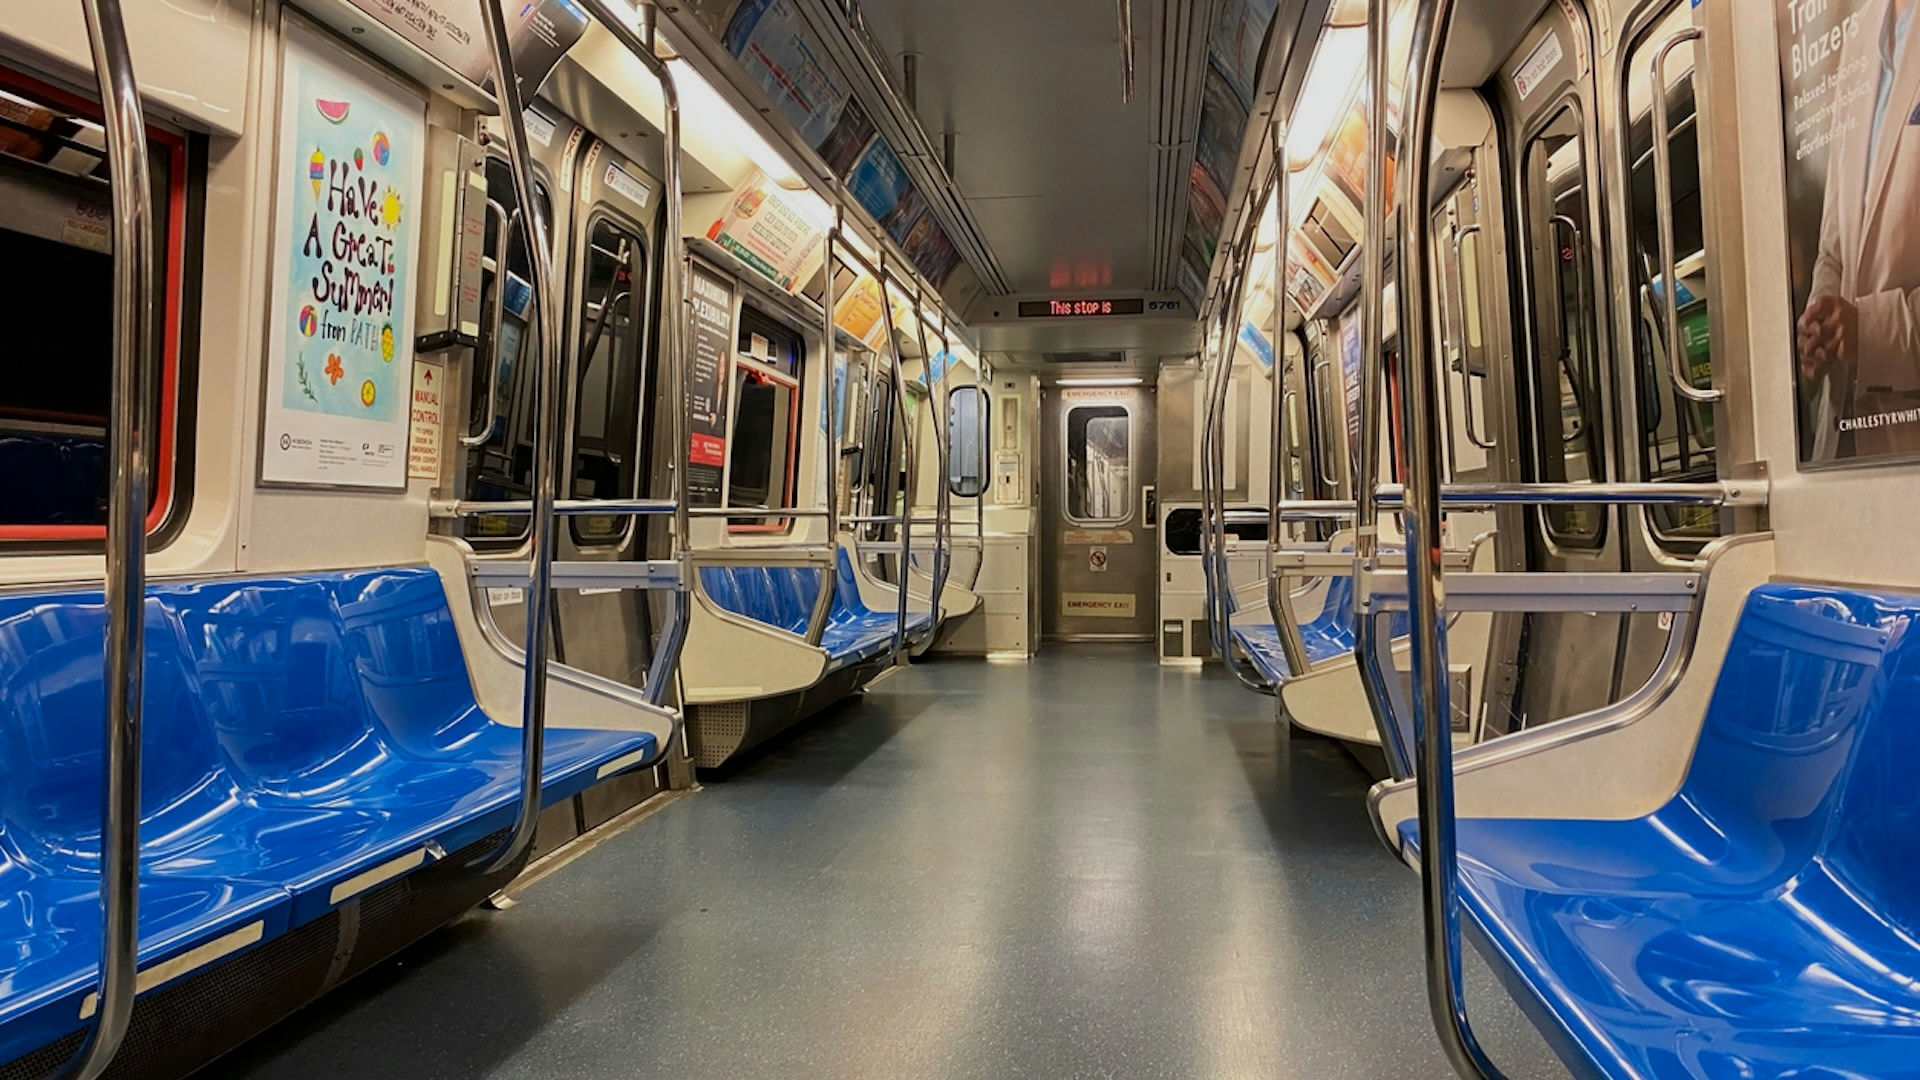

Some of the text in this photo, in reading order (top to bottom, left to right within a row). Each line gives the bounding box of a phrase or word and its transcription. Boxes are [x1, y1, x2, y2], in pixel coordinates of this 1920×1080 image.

[1788, 0, 1827, 34] Tra
[1792, 12, 1859, 80] Blazers
[1793, 74, 1826, 112] Relaxed
[1794, 101, 1838, 137] innovative
[303, 212, 322, 259] A
[1050, 301, 1112, 315] This stop is
[321, 309, 380, 351] from PATH
[415, 390, 439, 406] MANUAL
[1067, 390, 1113, 398] EMERGENCY
[412, 408, 440, 425] CONTROL
[411, 445, 437, 455] EMERGENCY
[1066, 600, 1130, 609] EMERGENCY EXIT
